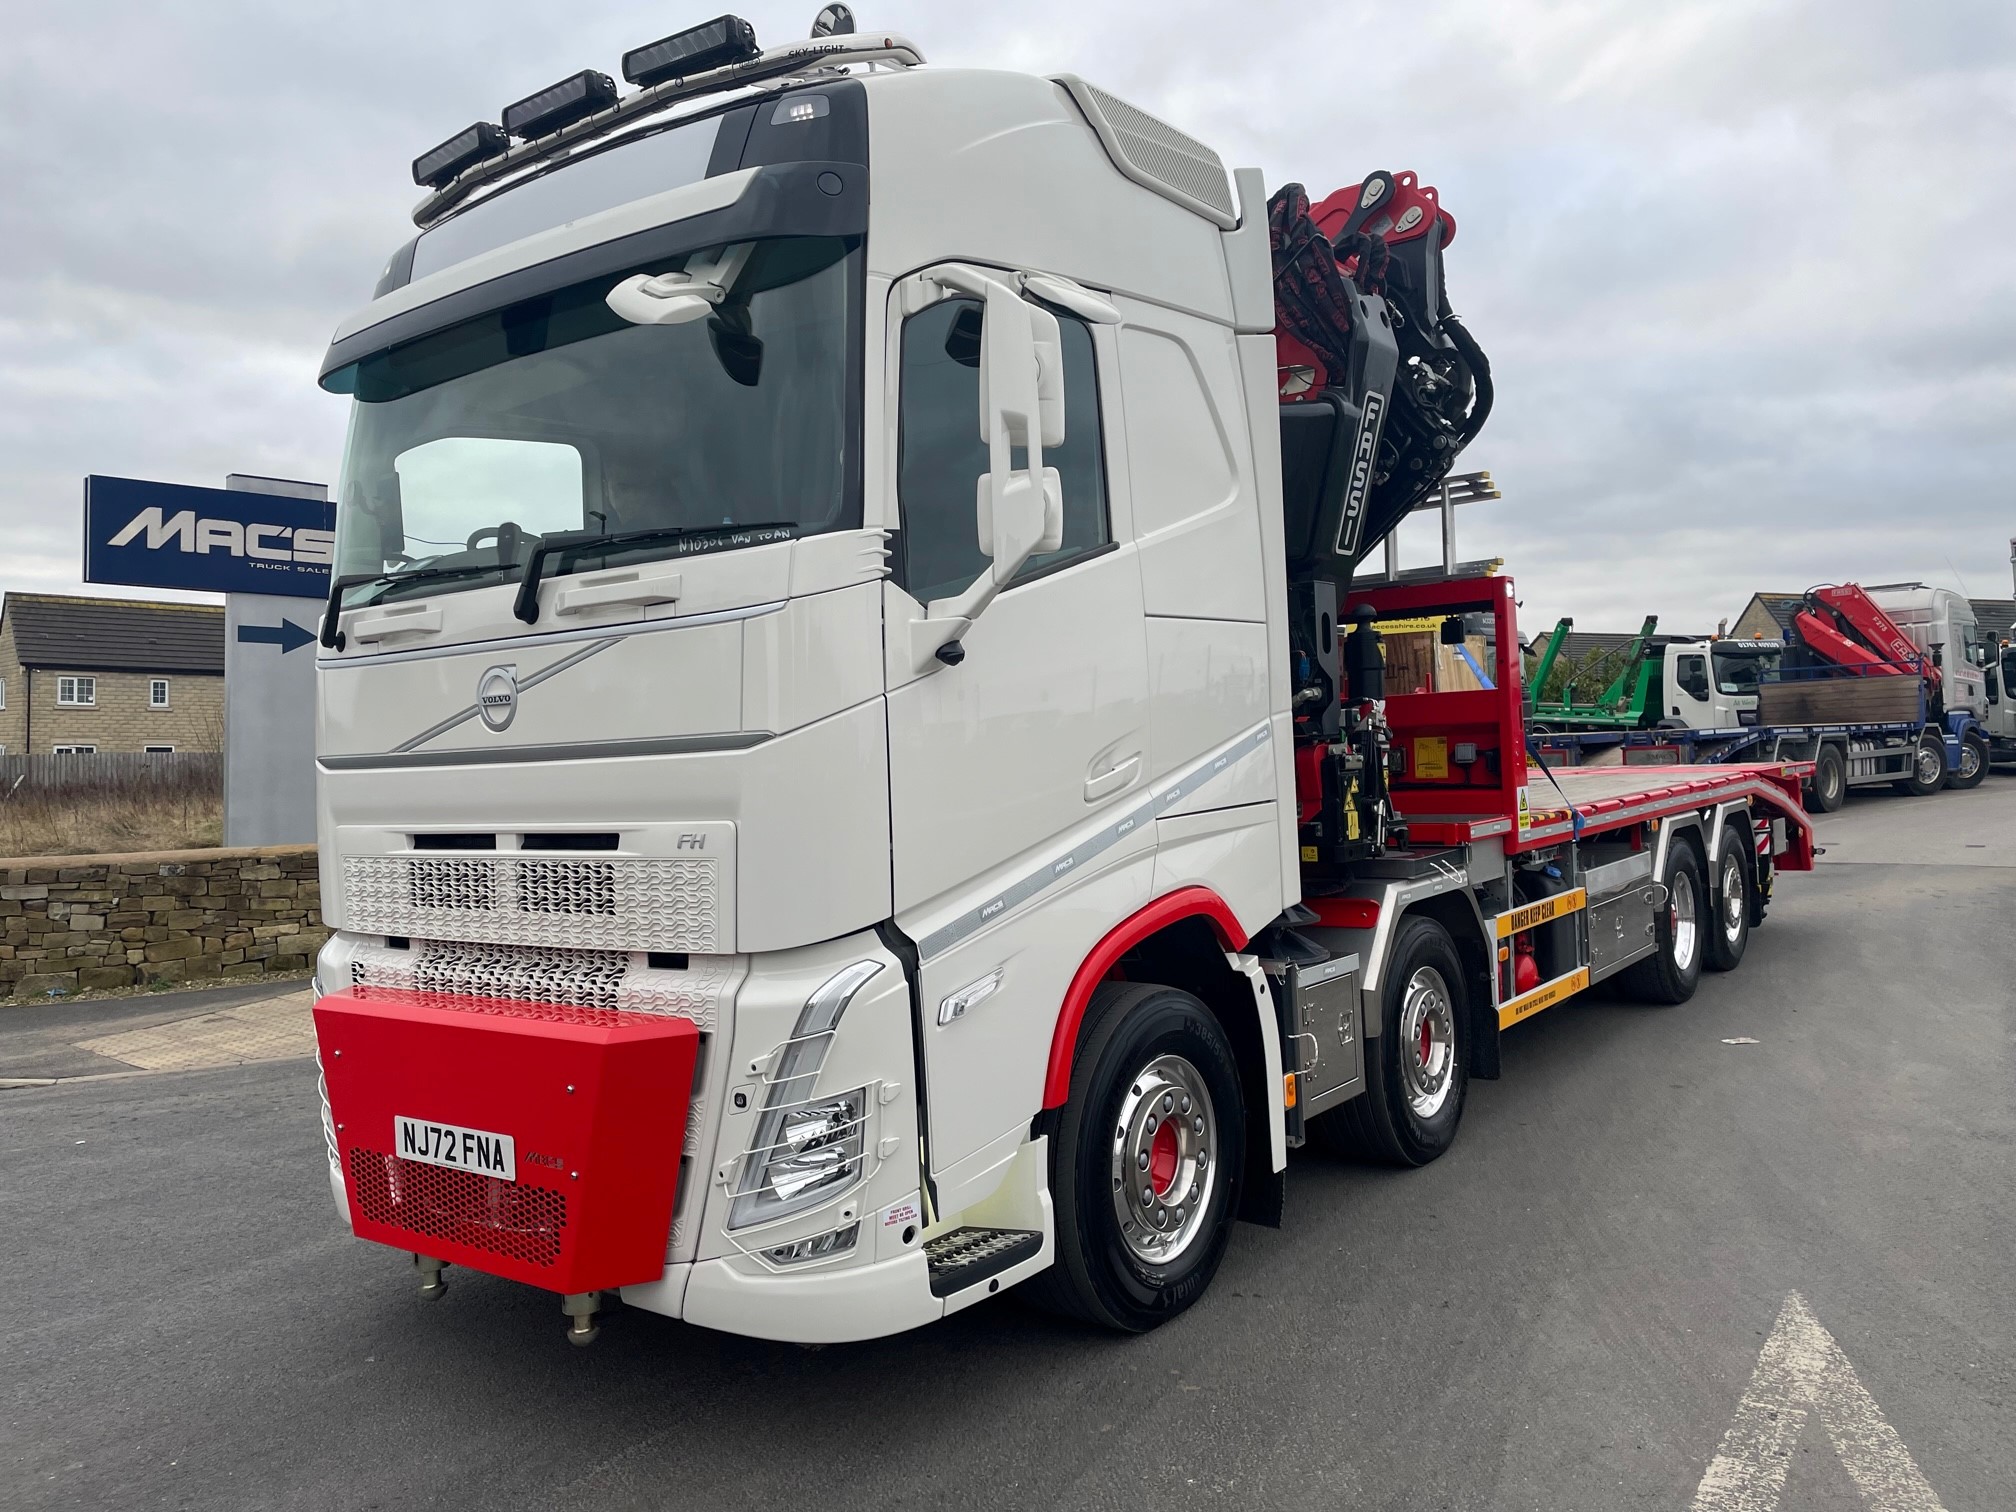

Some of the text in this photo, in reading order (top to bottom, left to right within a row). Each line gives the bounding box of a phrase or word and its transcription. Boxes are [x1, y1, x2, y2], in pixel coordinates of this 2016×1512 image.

[789, 44, 845, 58] SKY-LIGHT
[1344, 401, 1380, 546] FASSI
[248, 562, 331, 575] TRUCK SALE
[482, 695, 511, 704] VOLVO
[677, 833, 706, 850] FH
[403, 1121, 506, 1173] NJ72 FNA
